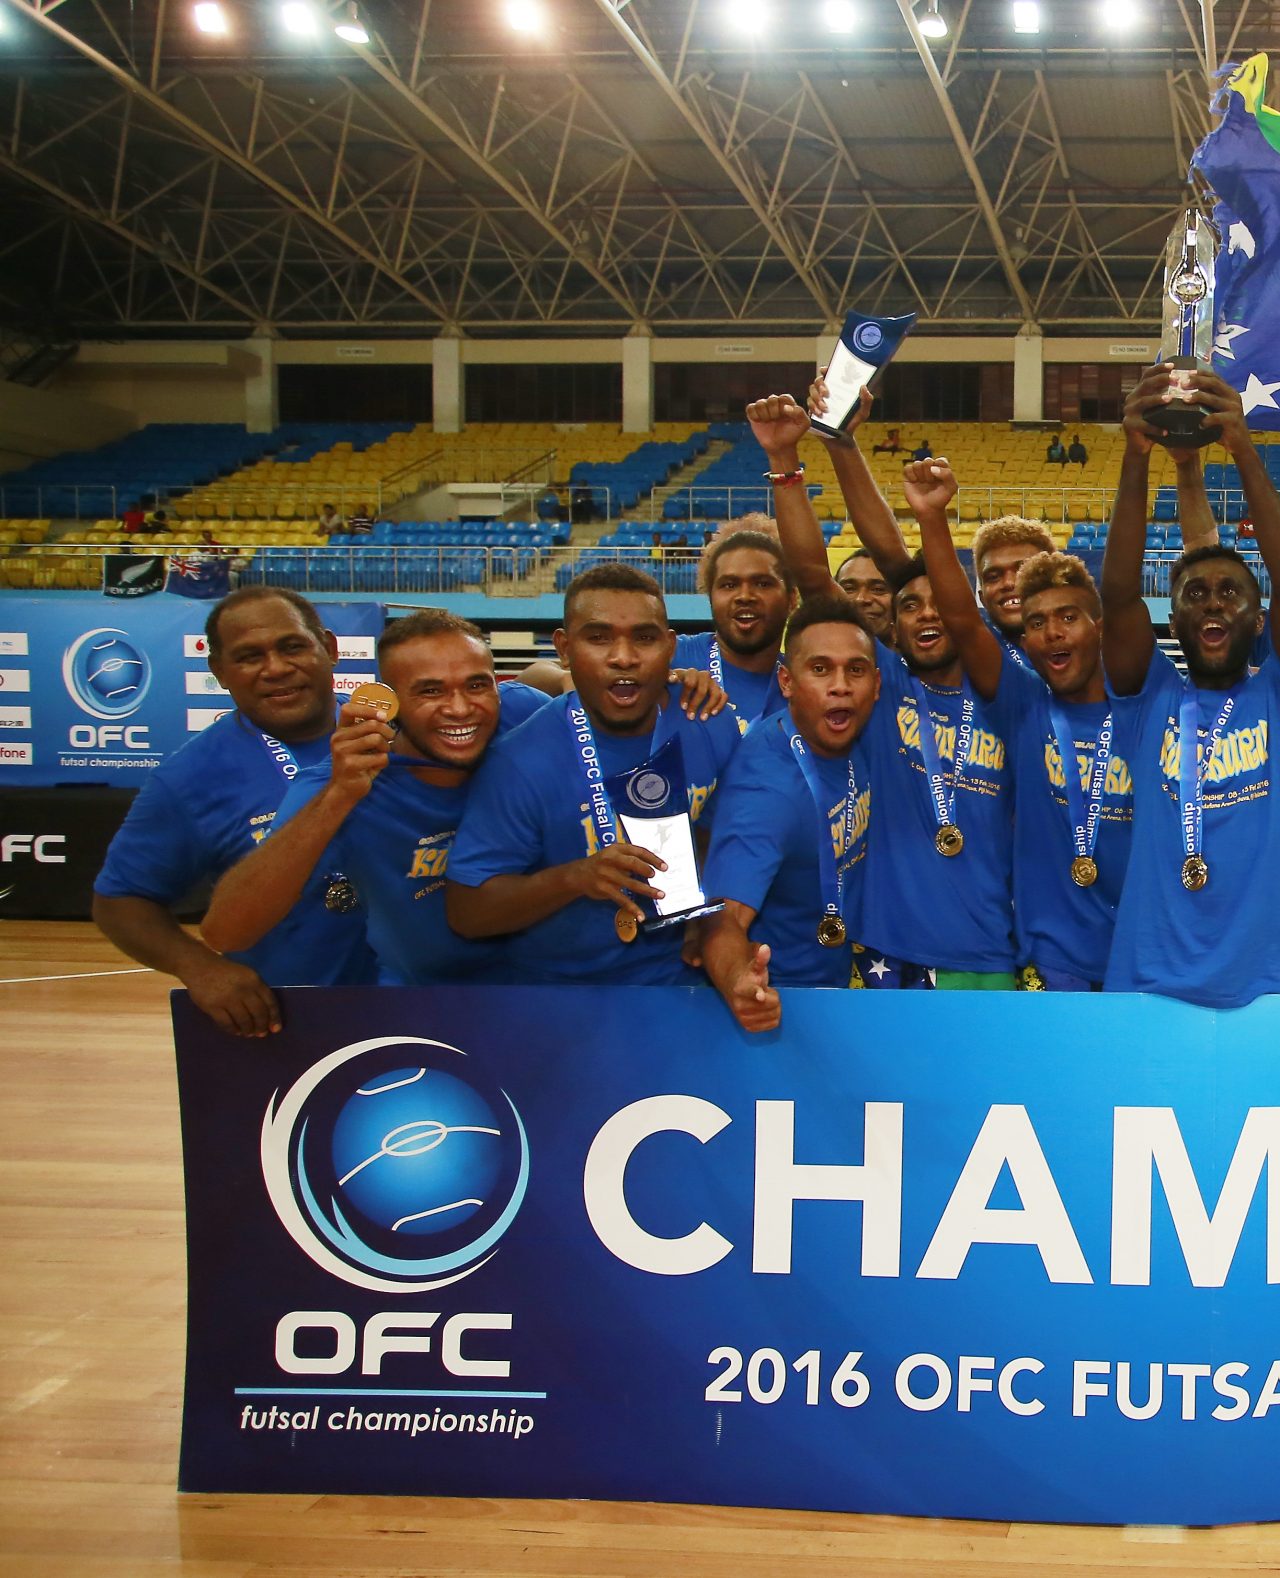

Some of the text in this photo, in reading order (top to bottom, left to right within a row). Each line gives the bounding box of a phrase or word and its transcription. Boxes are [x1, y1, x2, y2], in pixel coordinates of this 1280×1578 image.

[570, 707, 592, 743] 2016
[962, 698, 974, 722] 2016
[69, 725, 150, 749] OFC
[262, 733, 291, 762] 2016
[958, 724, 972, 749] OFC
[1097, 731, 1111, 758] OFC
[60, 757, 161, 769] futsal championship
[581, 746, 601, 780] OFC
[1091, 761, 1107, 800] Futsal
[590, 782, 613, 829] Futsal
[1, 834, 67, 863] FC
[275, 1311, 513, 1378] OFC
[704, 1347, 869, 1408] 2016
[895, 1353, 1046, 1416] OFC
[240, 1405, 535, 1439] futsal championship
